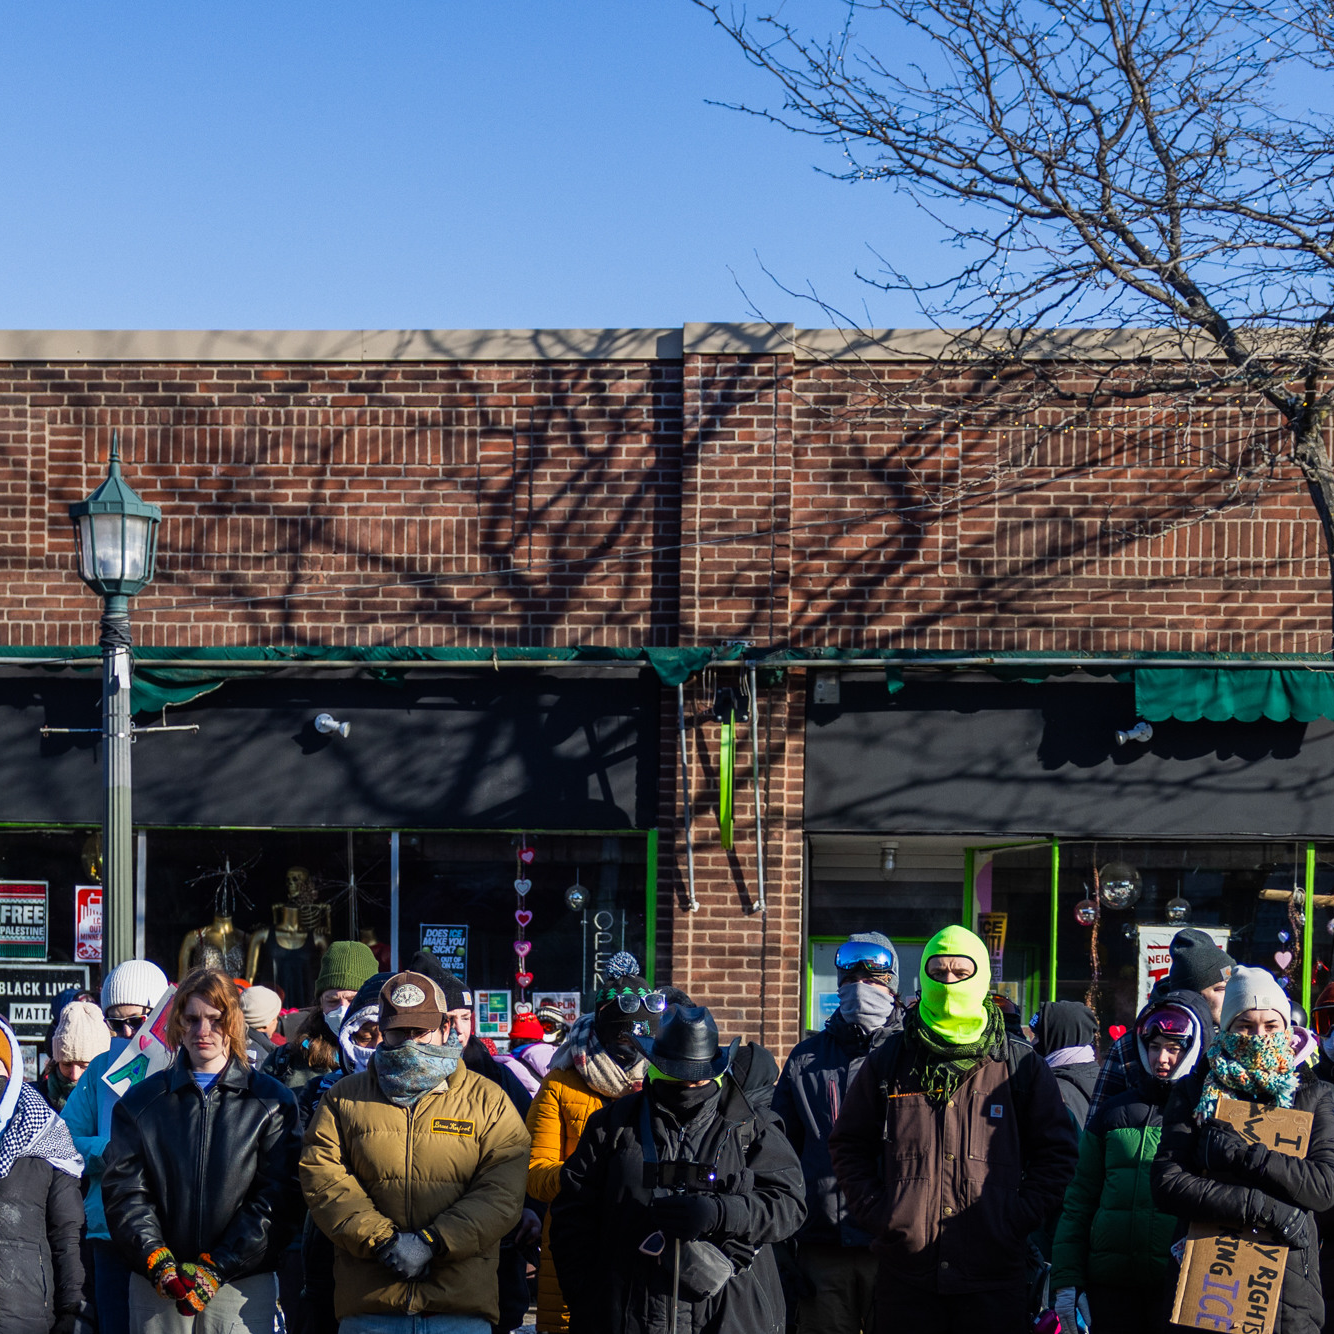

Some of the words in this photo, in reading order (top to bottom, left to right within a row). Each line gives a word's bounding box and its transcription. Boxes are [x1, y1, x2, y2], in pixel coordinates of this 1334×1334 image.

[0, 905, 44, 924] FREE
[0, 926, 44, 936] PALESTINE
[426, 929, 448, 937] DOES
[449, 929, 463, 938] ICE
[423, 937, 447, 946] MAKE
[448, 938, 465, 946] YOU
[432, 945, 456, 954] SICK?
[1148, 955, 1171, 964] NEIG
[14, 1008, 52, 1020] MATT
[1253, 1246, 1280, 1262] Y
[1195, 1273, 1240, 1333] ICE
